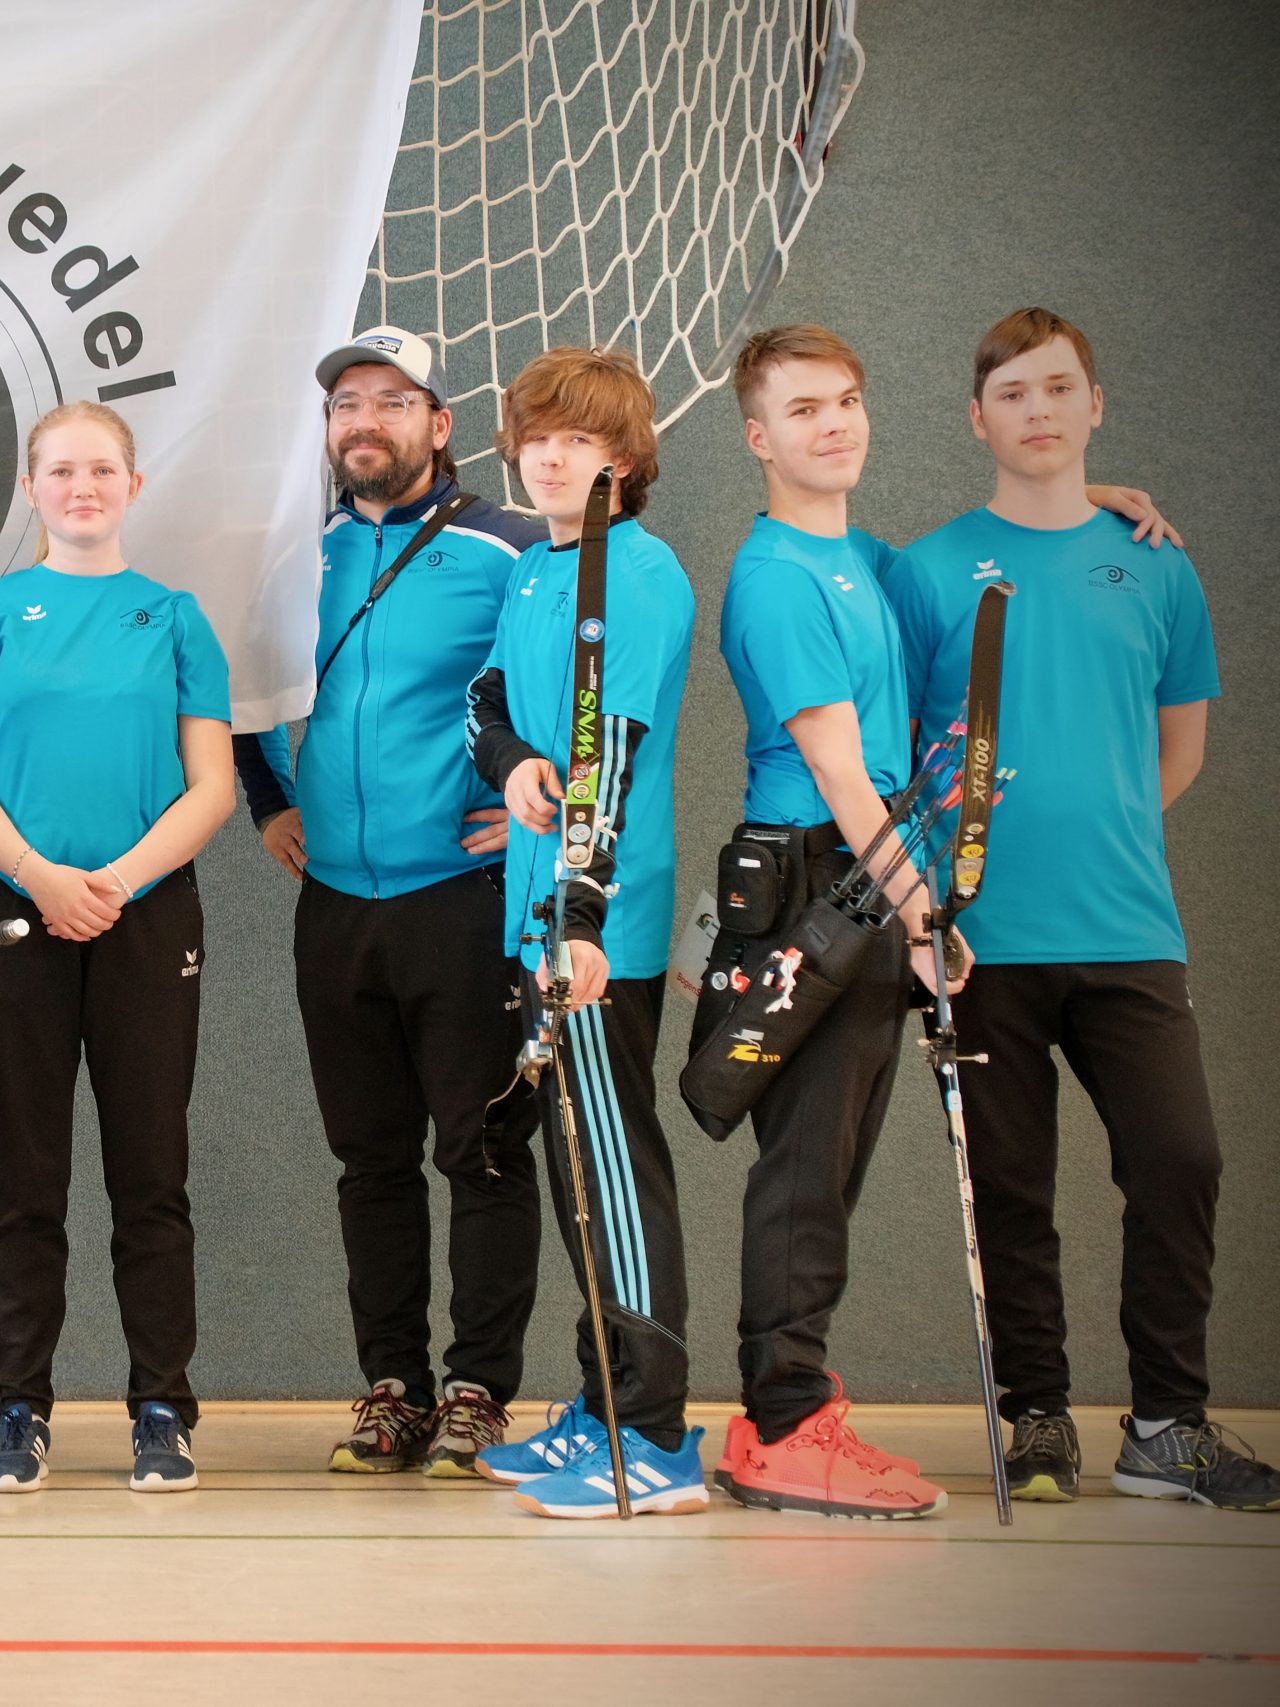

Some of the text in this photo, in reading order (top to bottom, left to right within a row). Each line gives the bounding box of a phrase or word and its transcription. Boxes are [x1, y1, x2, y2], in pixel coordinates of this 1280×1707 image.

[576, 689, 597, 759] WNS
[972, 737, 990, 802] XT-100
[761, 1054, 781, 1063] 310
